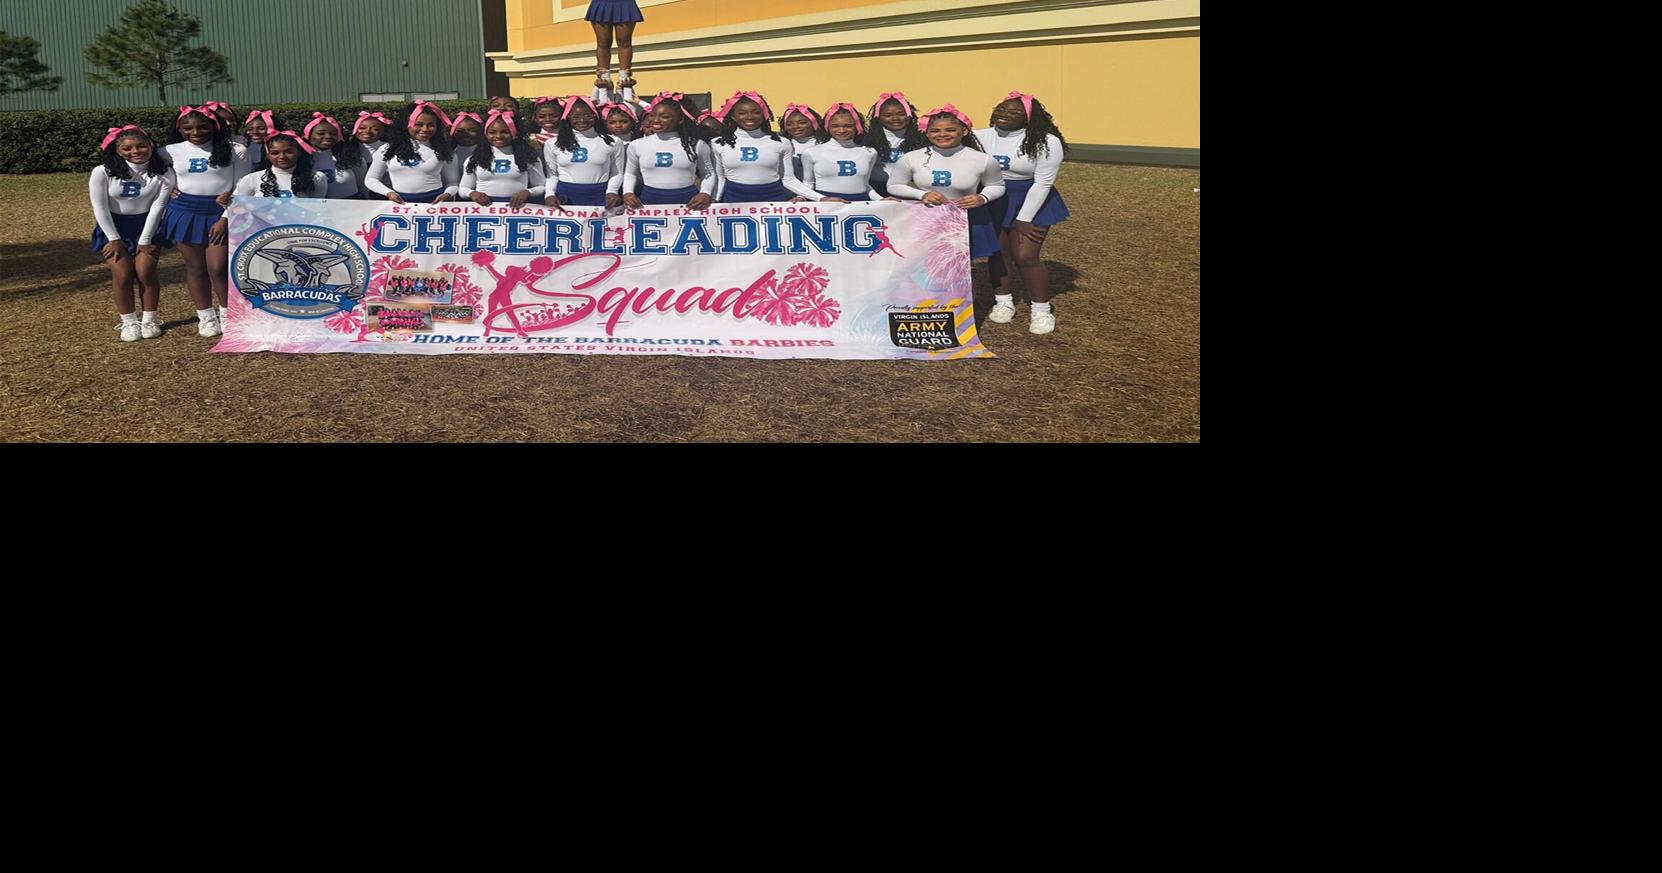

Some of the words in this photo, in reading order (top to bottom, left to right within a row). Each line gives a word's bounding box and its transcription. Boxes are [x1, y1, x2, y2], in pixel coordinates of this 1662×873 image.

[571, 147, 588, 162] B
[655, 152, 674, 168] B
[740, 147, 759, 162] B
[188, 158, 208, 173] B
[491, 159, 511, 173] B
[837, 161, 857, 176] B
[993, 155, 1011, 171] B
[931, 170, 952, 187] B
[120, 181, 141, 198] B
[392, 206, 417, 214] ST.
[426, 206, 481, 215] CROIX
[489, 206, 608, 218] EDUCATIONAL
[700, 207, 741, 215] HIGH
[749, 206, 821, 214] SCHOOL
[370, 213, 885, 255] CHEERLEADING
[245, 227, 300, 252] EDUCATIONAL
[302, 227, 345, 246] COMPLEX
[343, 242, 360, 260] HIGH
[354, 259, 365, 285] SCHOO
[262, 290, 342, 303] BARRACUDAS
[483, 252, 776, 336] Squad
[897, 322, 947, 331] ARMY
[411, 335, 480, 344] HOME
[486, 336, 515, 344] OF
[573, 336, 722, 346] BARRACUDA
[729, 339, 835, 347] BARBIES
